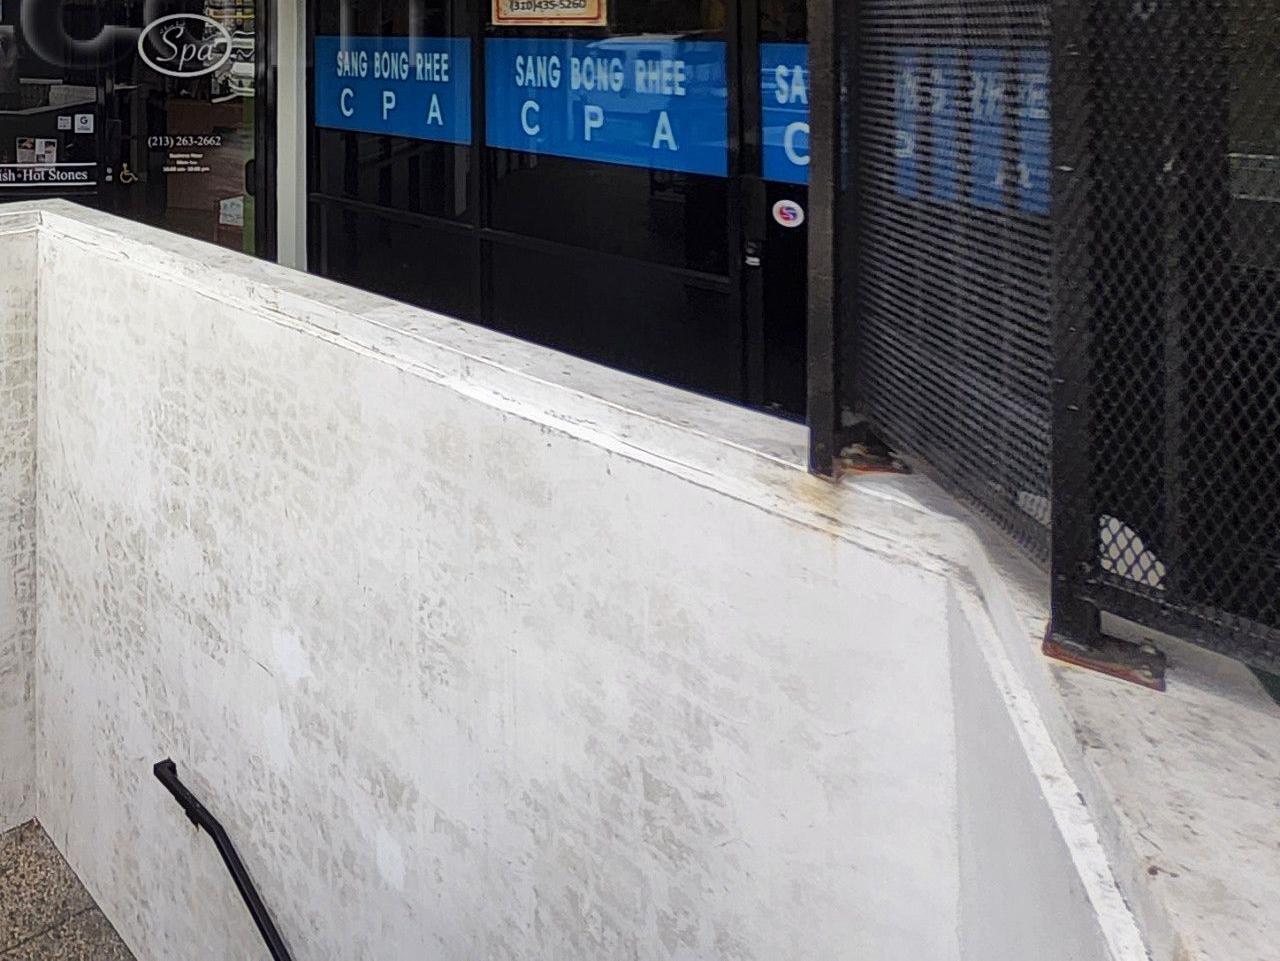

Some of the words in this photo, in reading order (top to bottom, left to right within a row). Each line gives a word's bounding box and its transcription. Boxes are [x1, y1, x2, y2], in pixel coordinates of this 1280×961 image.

[155, 25, 217, 71] Spa
[337, 51, 368, 78] SANG
[374, 51, 409, 80] BONG
[416, 52, 449, 82] RHEE
[515, 55, 561, 88] SANG
[571, 56, 624, 92] BONG
[635, 59, 686, 95] RHEE
[341, 88, 354, 117] C
[383, 91, 396, 120] P
[426, 93, 443, 126] A
[521, 100, 540, 135] C
[584, 105, 604, 141] P
[652, 111, 679, 150] A
[147, 136, 174, 148] (213)
[176, 136, 221, 147] 263-2662
[22, 169, 45, 181] Hot
[48, 169, 88, 180] Stones
